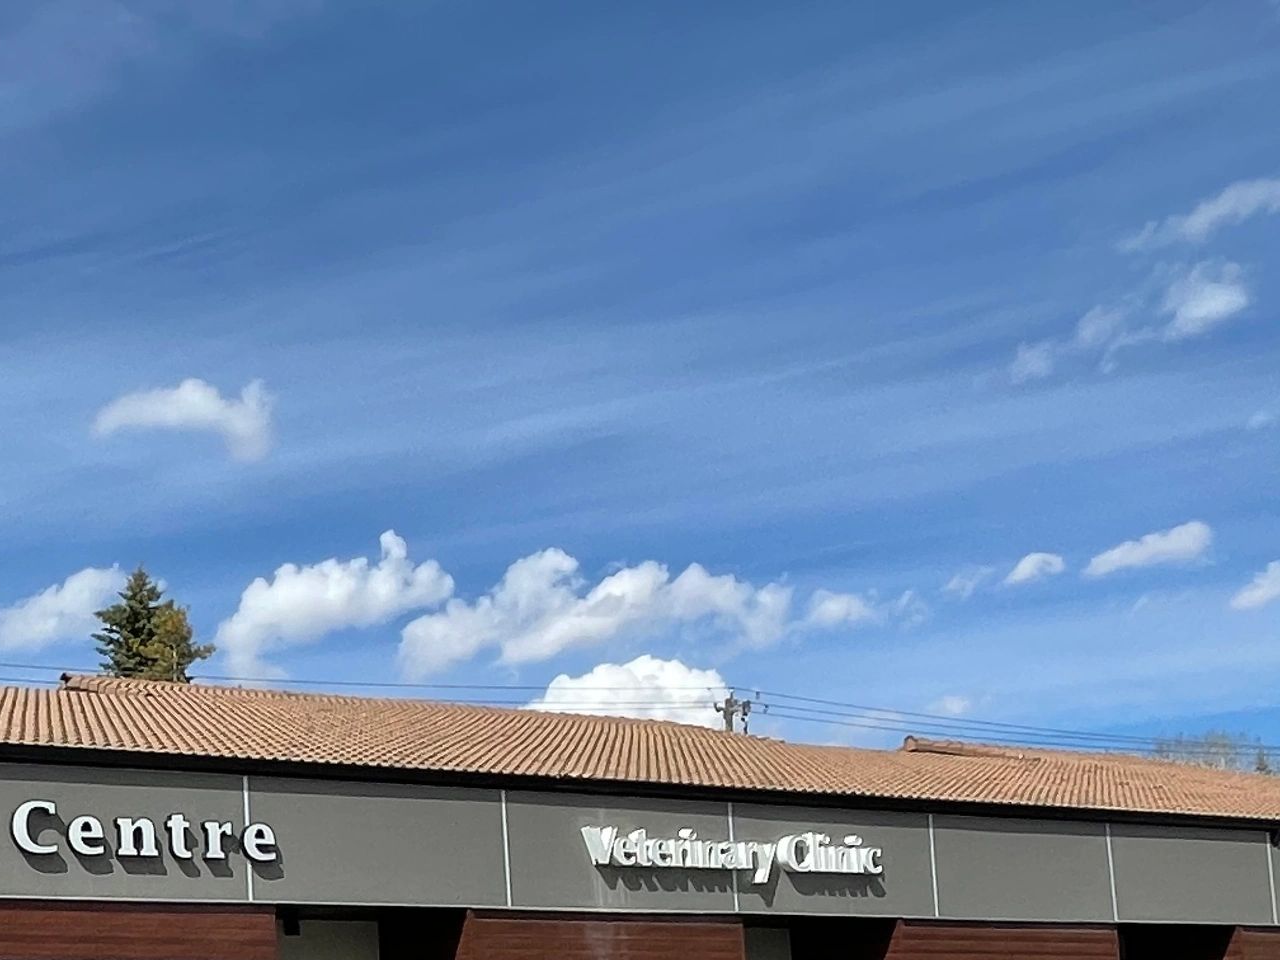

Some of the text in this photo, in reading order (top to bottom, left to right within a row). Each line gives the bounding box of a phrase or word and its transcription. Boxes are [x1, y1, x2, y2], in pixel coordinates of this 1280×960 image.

[10, 799, 279, 863] Centre
[580, 824, 884, 885] Veterinary Clinic
